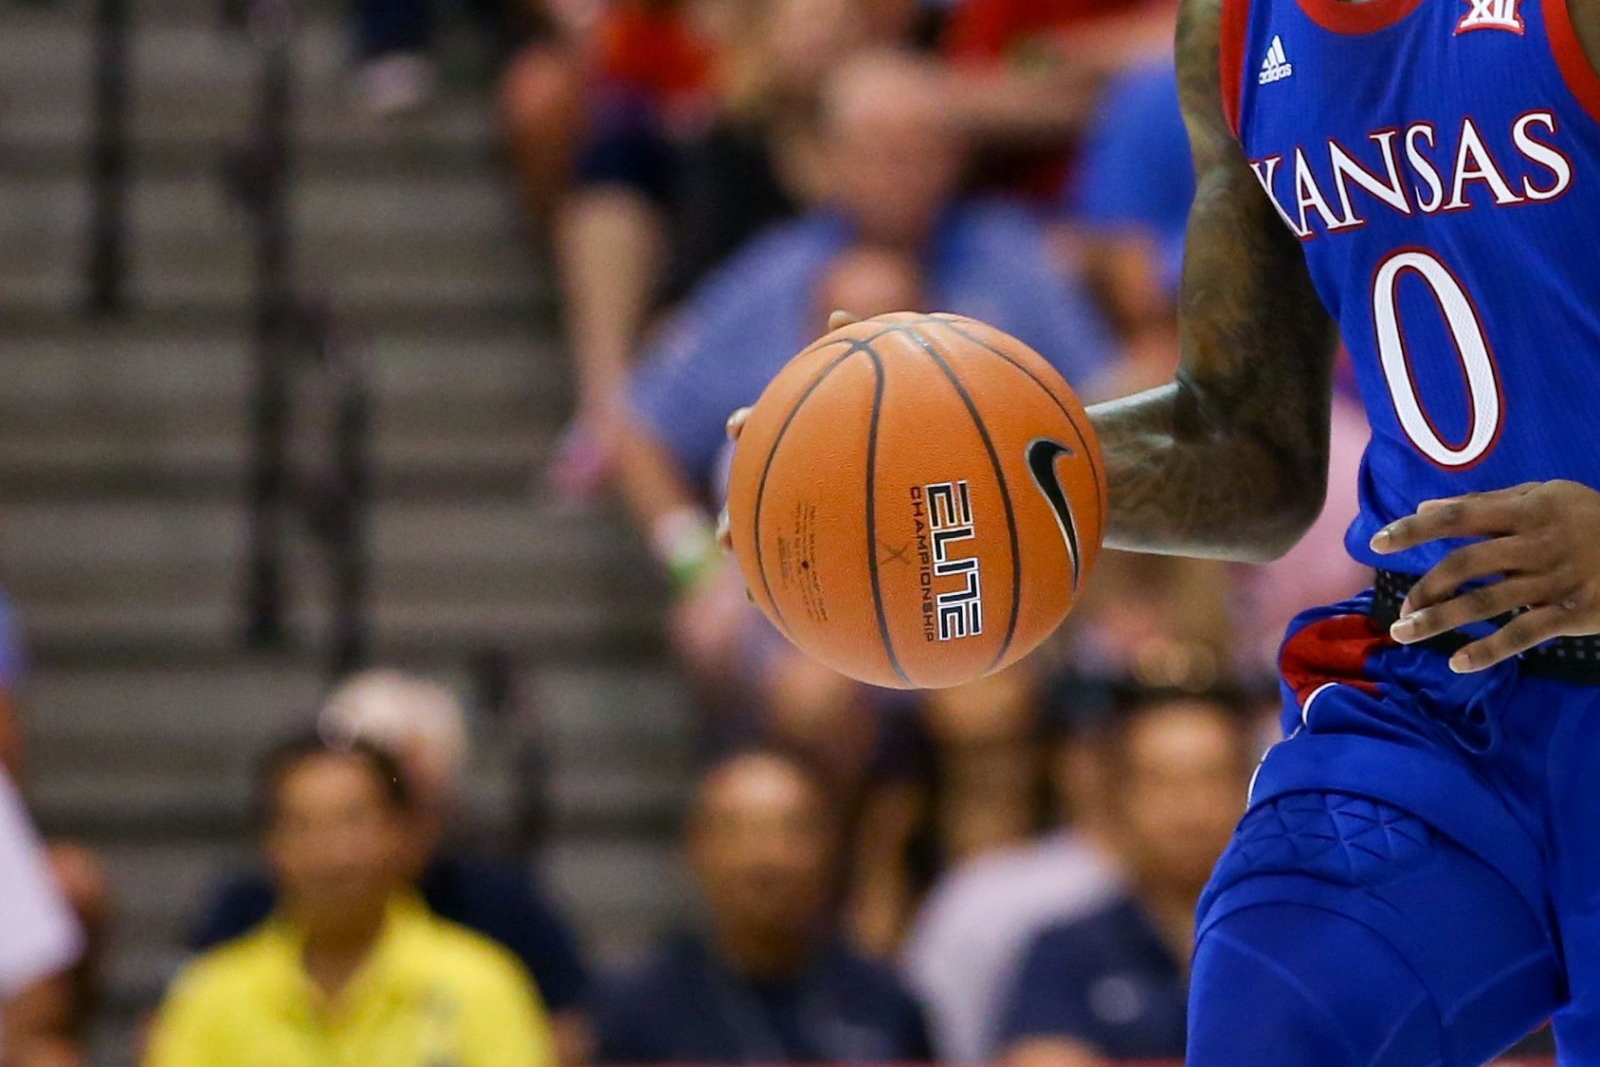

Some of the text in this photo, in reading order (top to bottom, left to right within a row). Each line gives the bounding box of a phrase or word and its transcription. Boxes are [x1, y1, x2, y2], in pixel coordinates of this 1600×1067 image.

[1258, 62, 1293, 85] adidas
[1372, 247, 1502, 471] 0
[910, 486, 934, 642] CHAMPIONSHIP
[925, 480, 982, 641] ELITE
